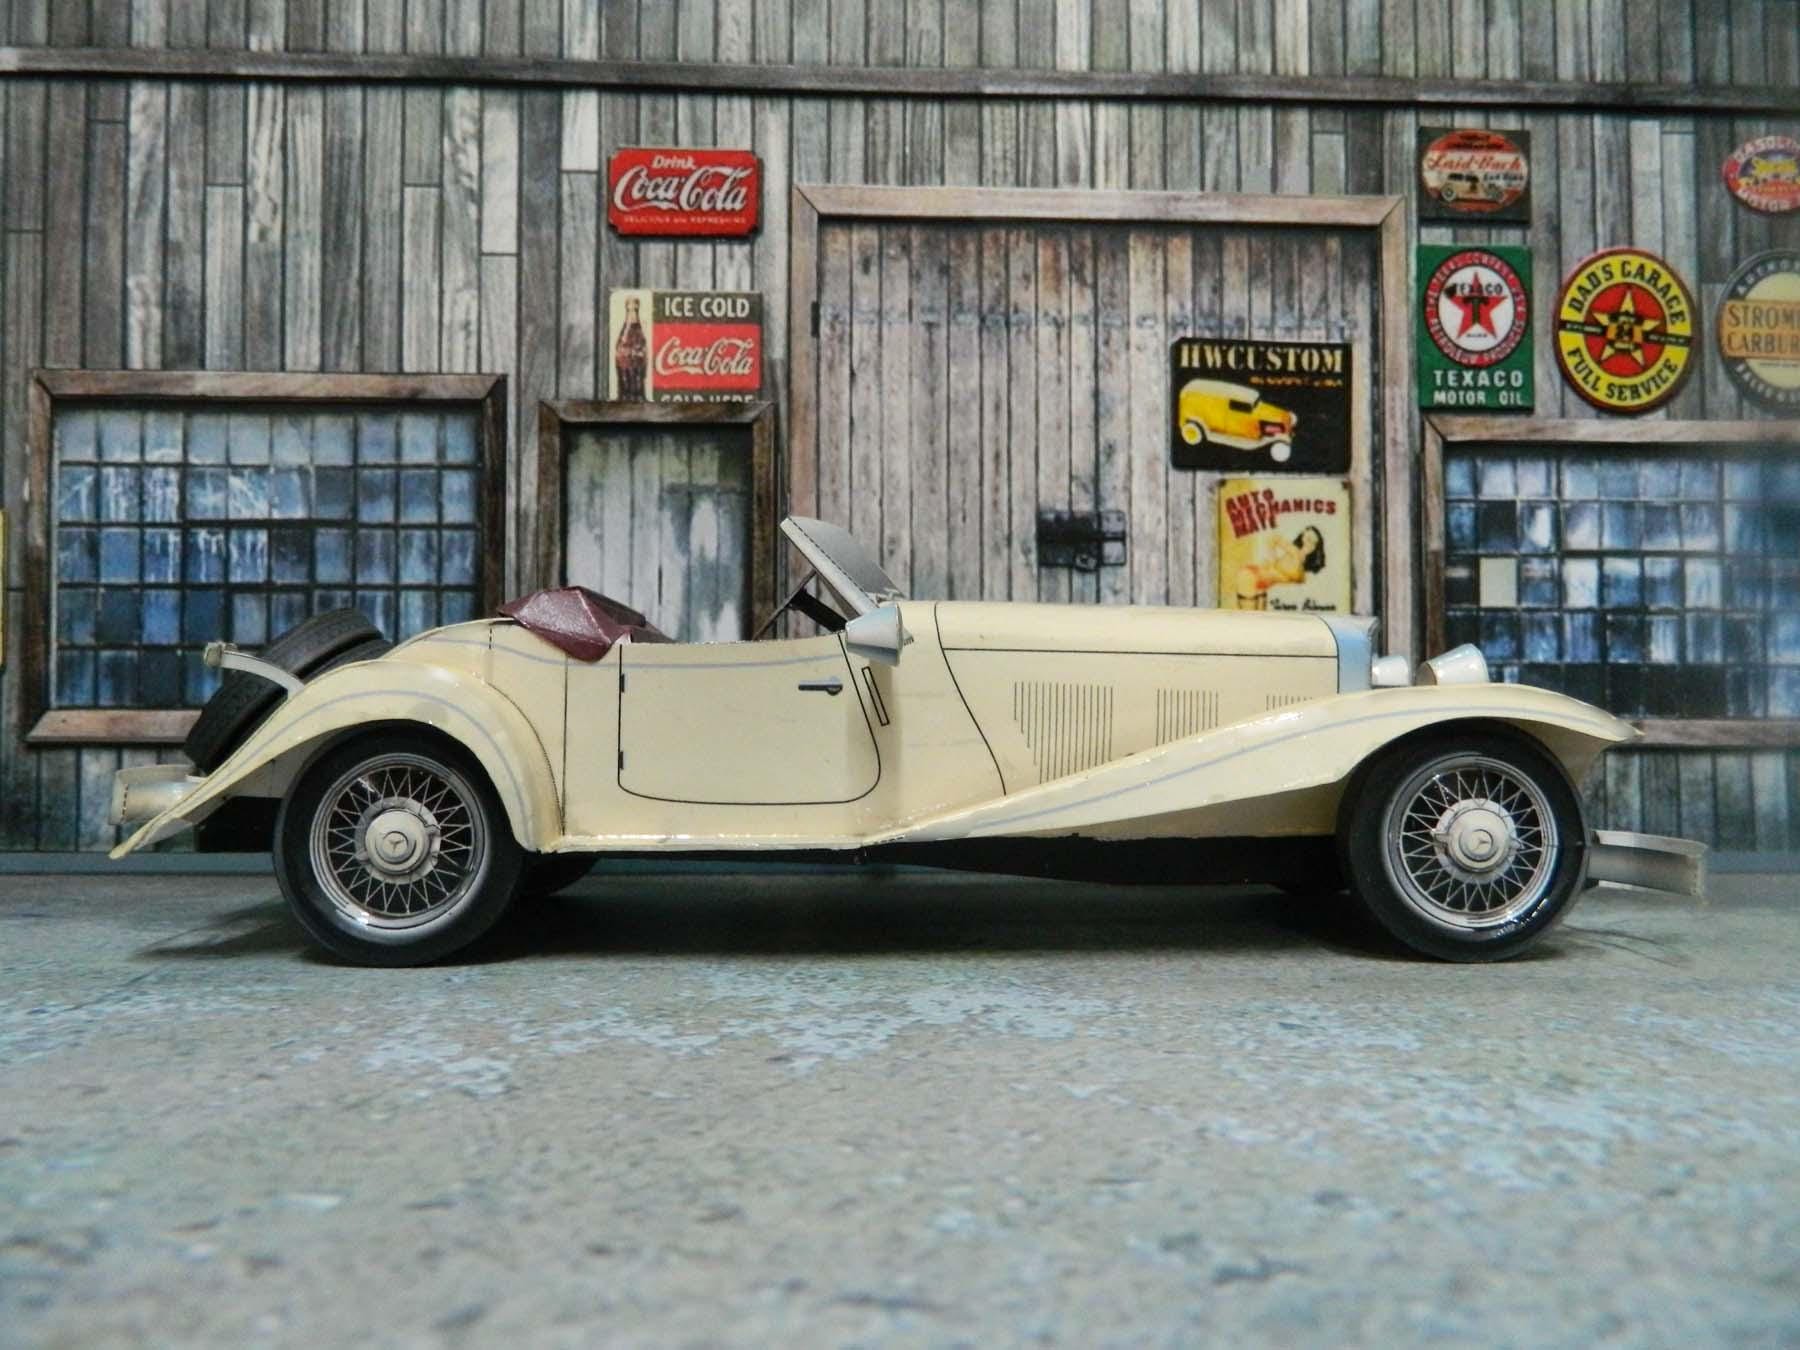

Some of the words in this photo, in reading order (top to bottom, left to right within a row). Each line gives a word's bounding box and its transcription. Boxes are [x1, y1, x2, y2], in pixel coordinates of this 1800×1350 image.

[652, 155, 698, 170] Drink
[1568, 263, 1614, 314] DAD'S
[664, 297, 694, 318] ICE
[700, 297, 750, 318] COLD
[1434, 370, 1524, 388] TEXACO
[1567, 346, 1602, 392] FULL
[1605, 357, 1678, 401] SERVICE
[1433, 391, 1486, 406] MOTOR
[1499, 391, 1523, 405] OIL
